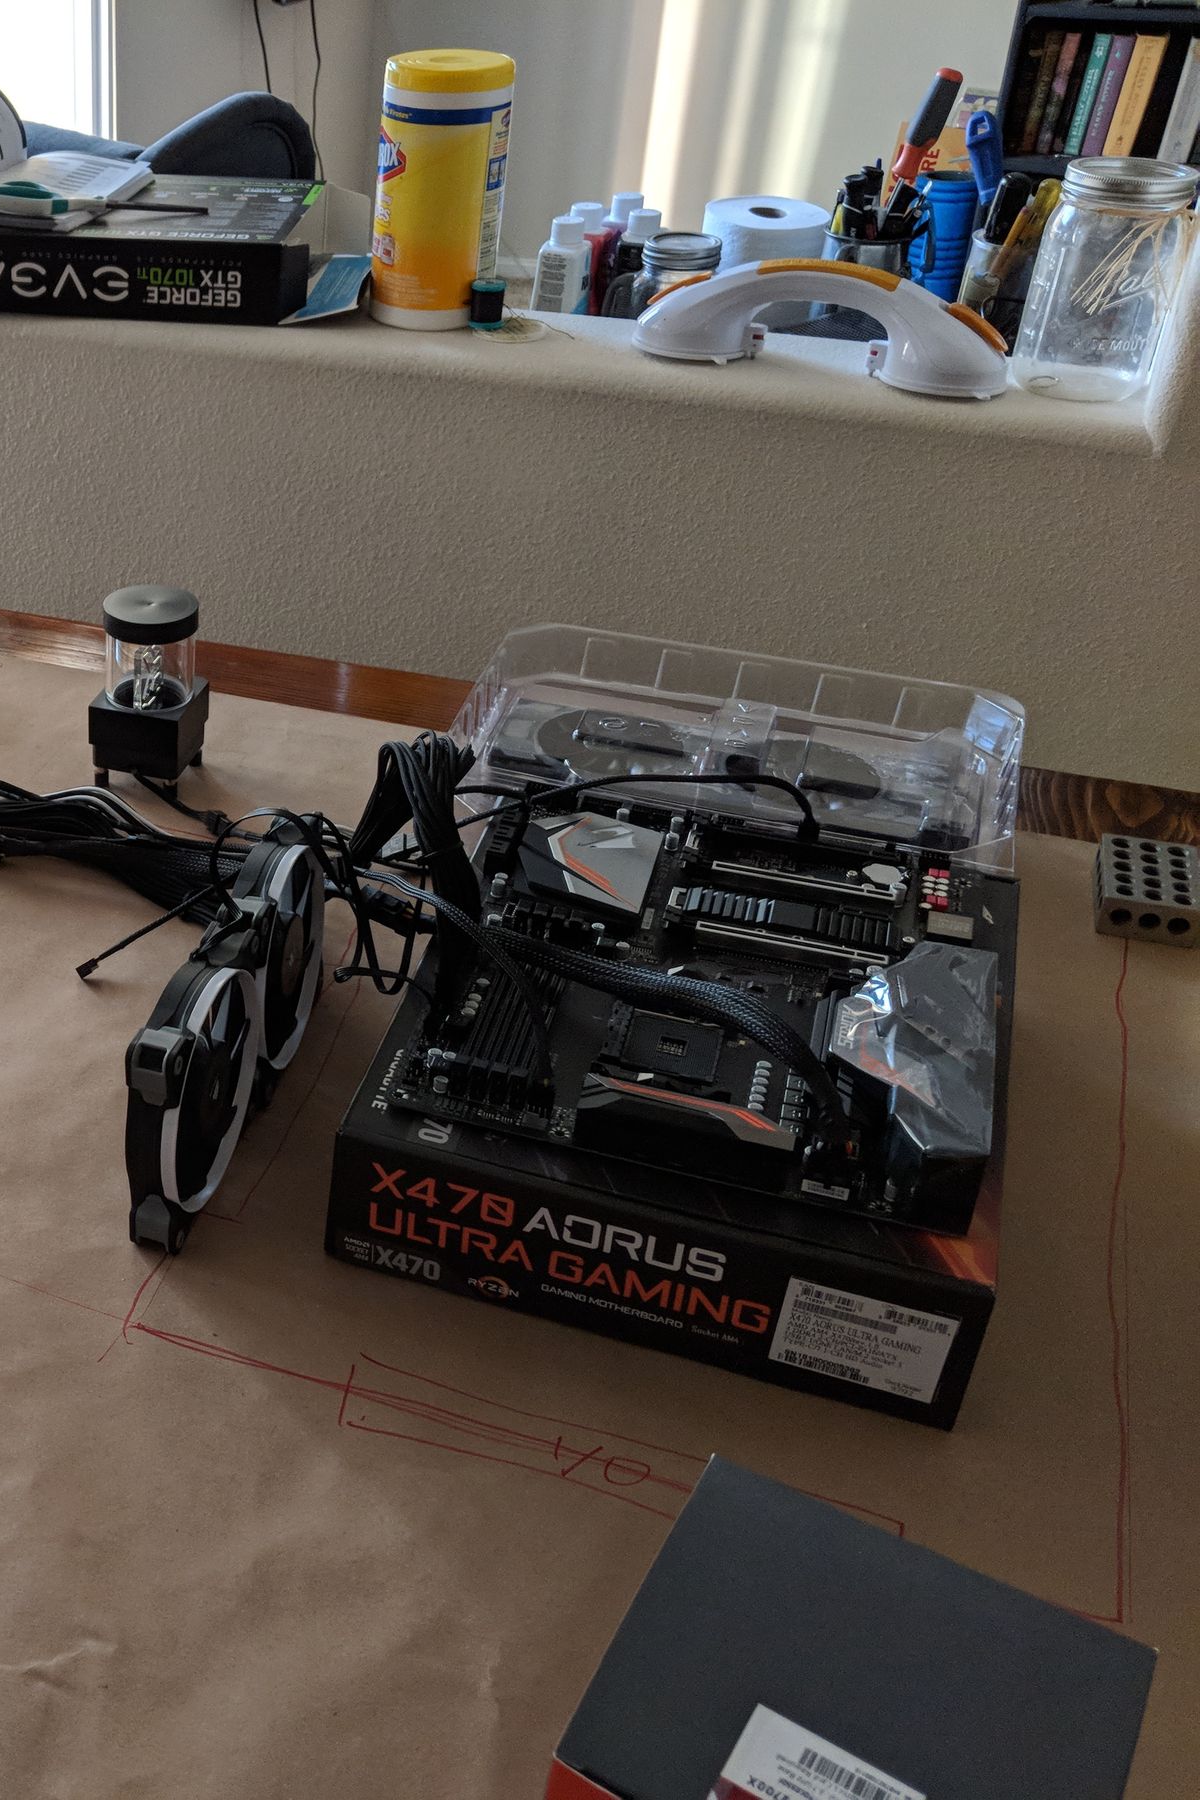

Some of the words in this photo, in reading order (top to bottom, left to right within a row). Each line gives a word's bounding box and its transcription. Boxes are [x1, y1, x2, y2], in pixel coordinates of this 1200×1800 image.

[145, 286, 242, 307] GEFORCE
[200, 269, 242, 288] GTX
[370, 1162, 515, 1228] X470
[522, 1206, 728, 1283] AORUS
[368, 1201, 535, 1272] ULTRA
[547, 1250, 772, 1335] GAMING
[374, 1245, 442, 1281] X470
[467, 1277, 520, 1299] RYZEN
[541, 1283, 587, 1303] GAMING
[588, 1297, 684, 1329] MOTHERBOARD
[812, 1318, 846, 1334] AORUS
[847, 1327, 879, 1343] ULTRA
[881, 1336, 922, 1354] GAMING
